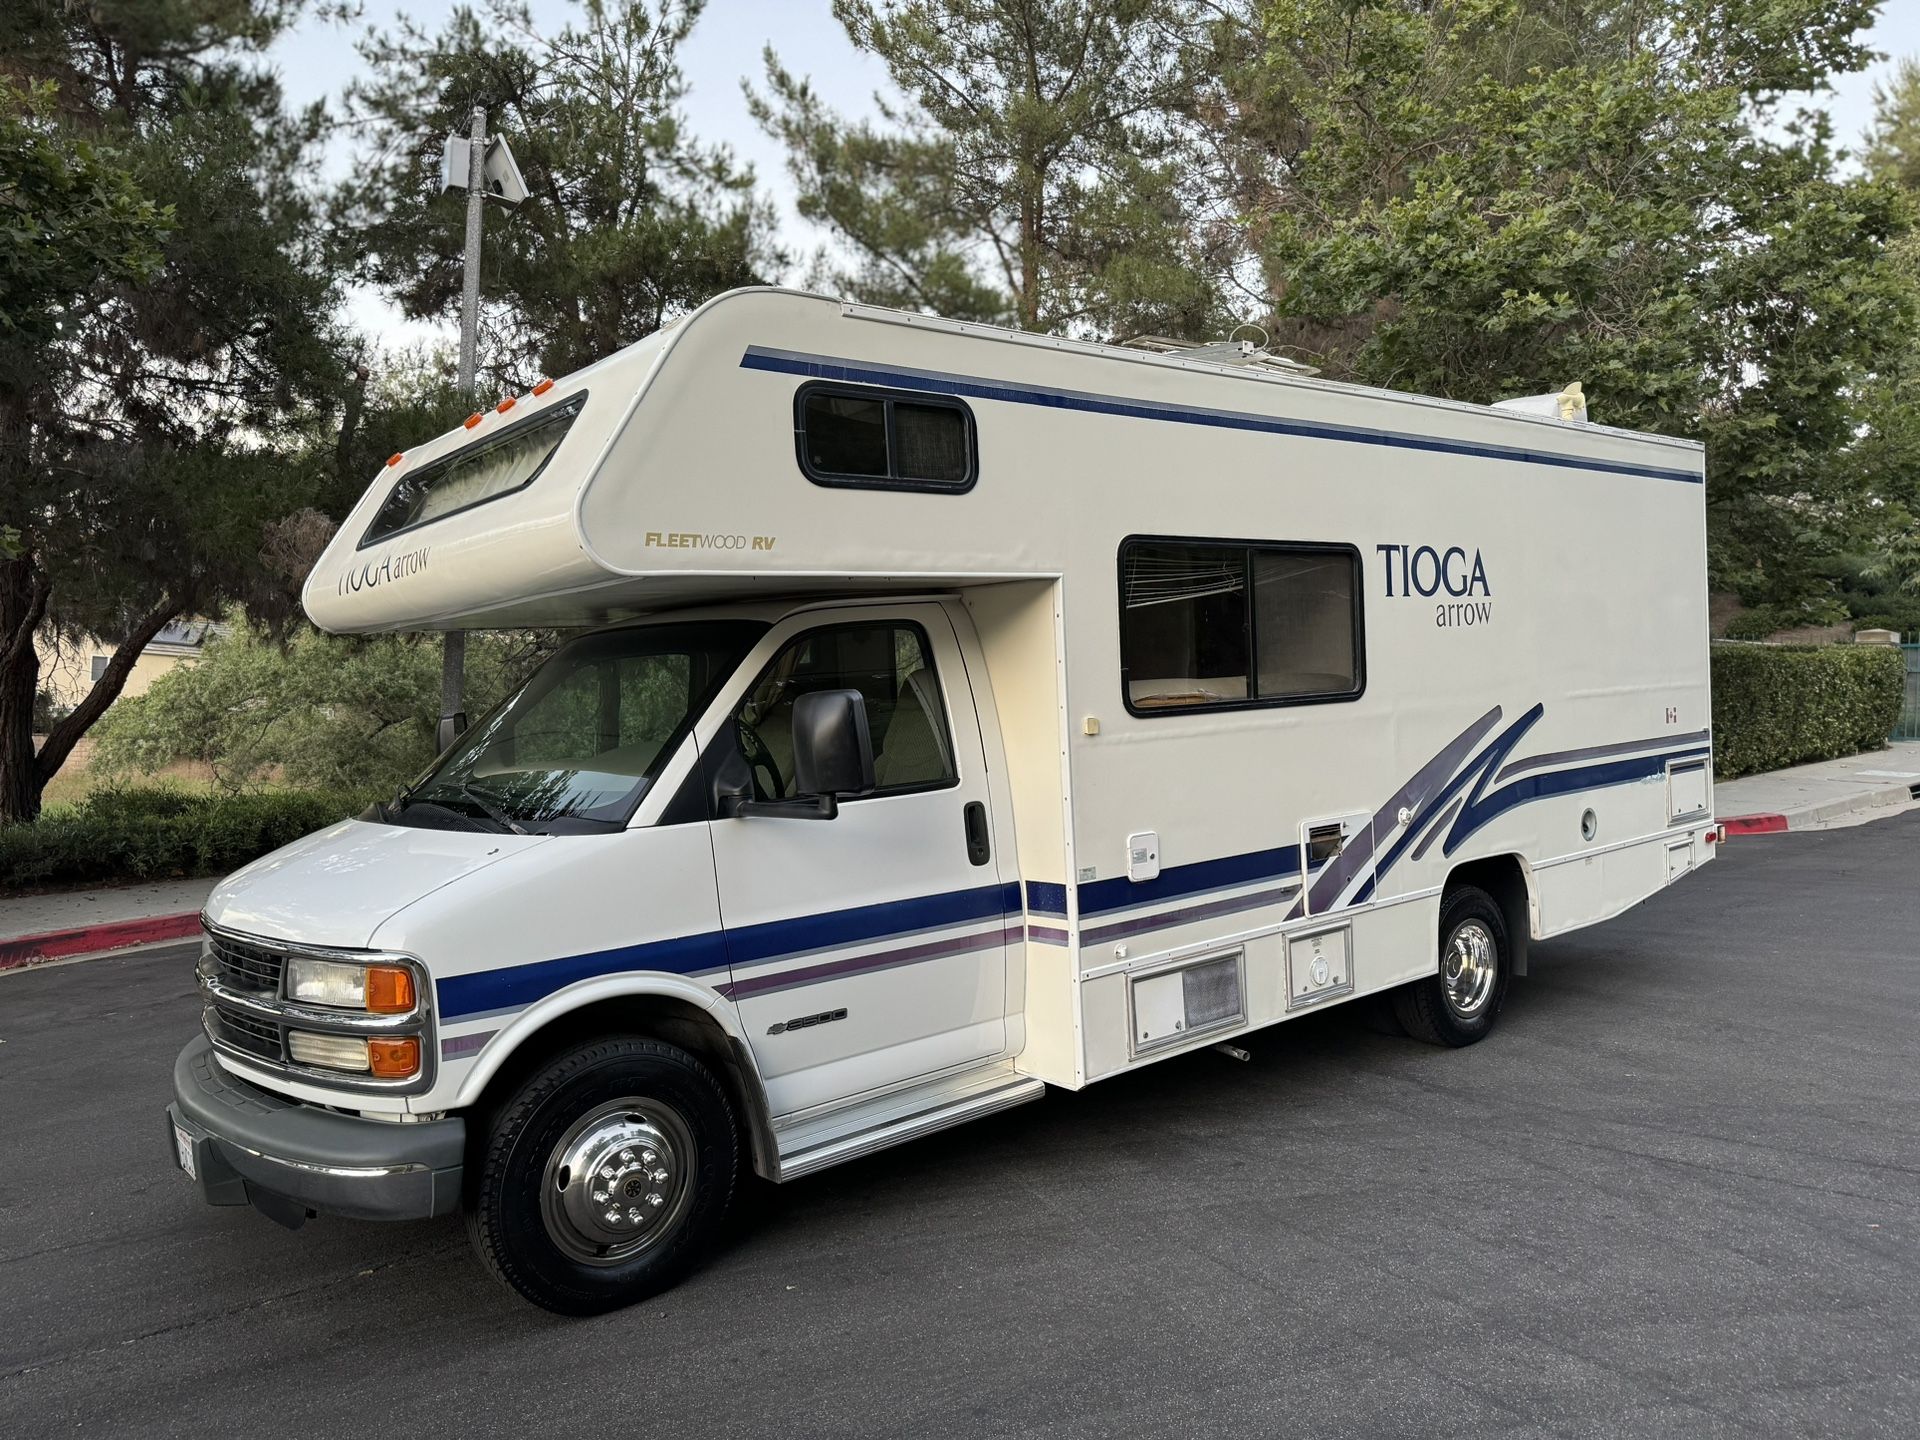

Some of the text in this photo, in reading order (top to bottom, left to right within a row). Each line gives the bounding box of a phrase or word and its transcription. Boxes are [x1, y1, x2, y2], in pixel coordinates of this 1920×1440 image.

[645, 532, 776, 551] FLEETWOOD RV
[393, 546, 431, 580] arrow
[1376, 544, 1491, 597] TIOGA
[1436, 602, 1492, 628] arrow
